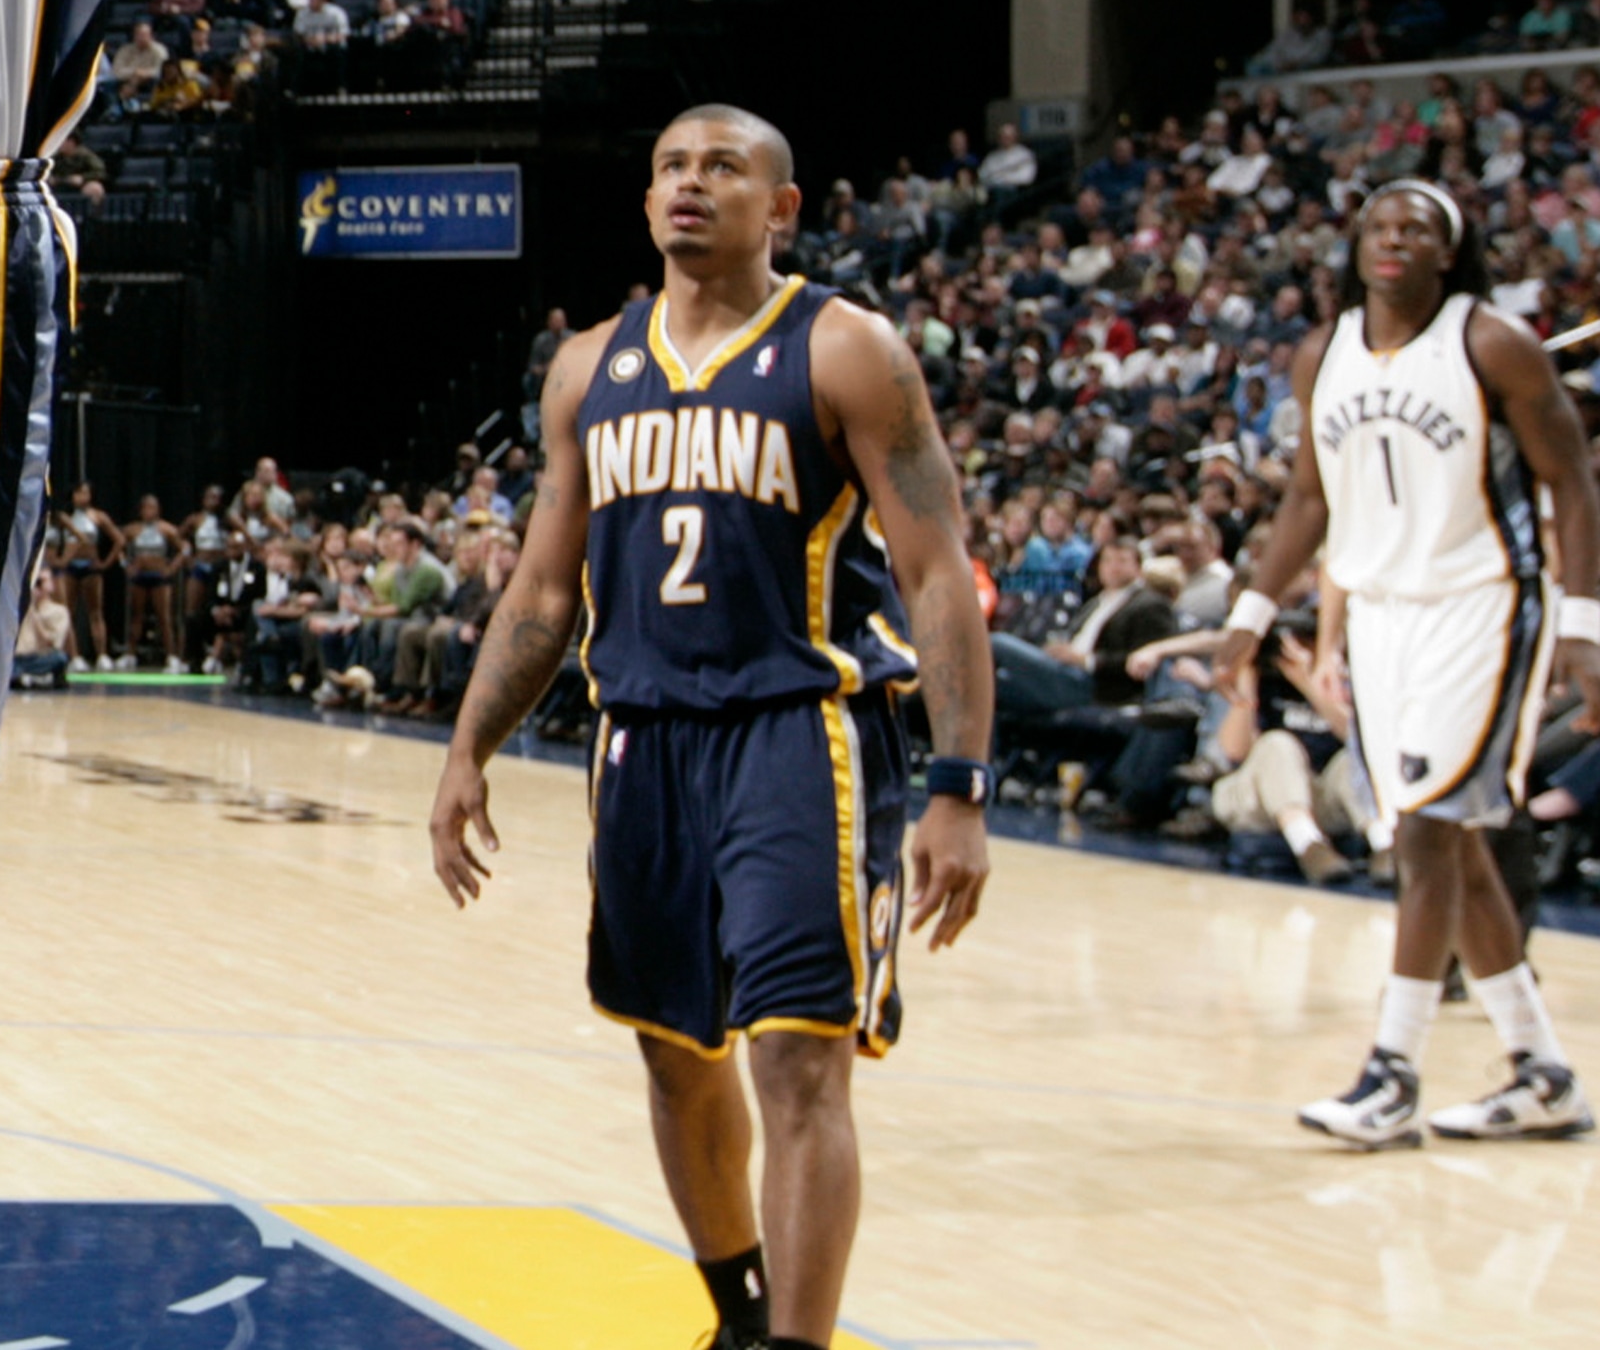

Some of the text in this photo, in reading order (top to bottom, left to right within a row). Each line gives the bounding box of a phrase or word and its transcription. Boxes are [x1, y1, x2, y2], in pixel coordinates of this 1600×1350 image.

[337, 193, 514, 220] COVENTRY
[585, 406, 800, 514] INDIANA
[1378, 435, 1398, 506] 1
[659, 504, 707, 605] 2
